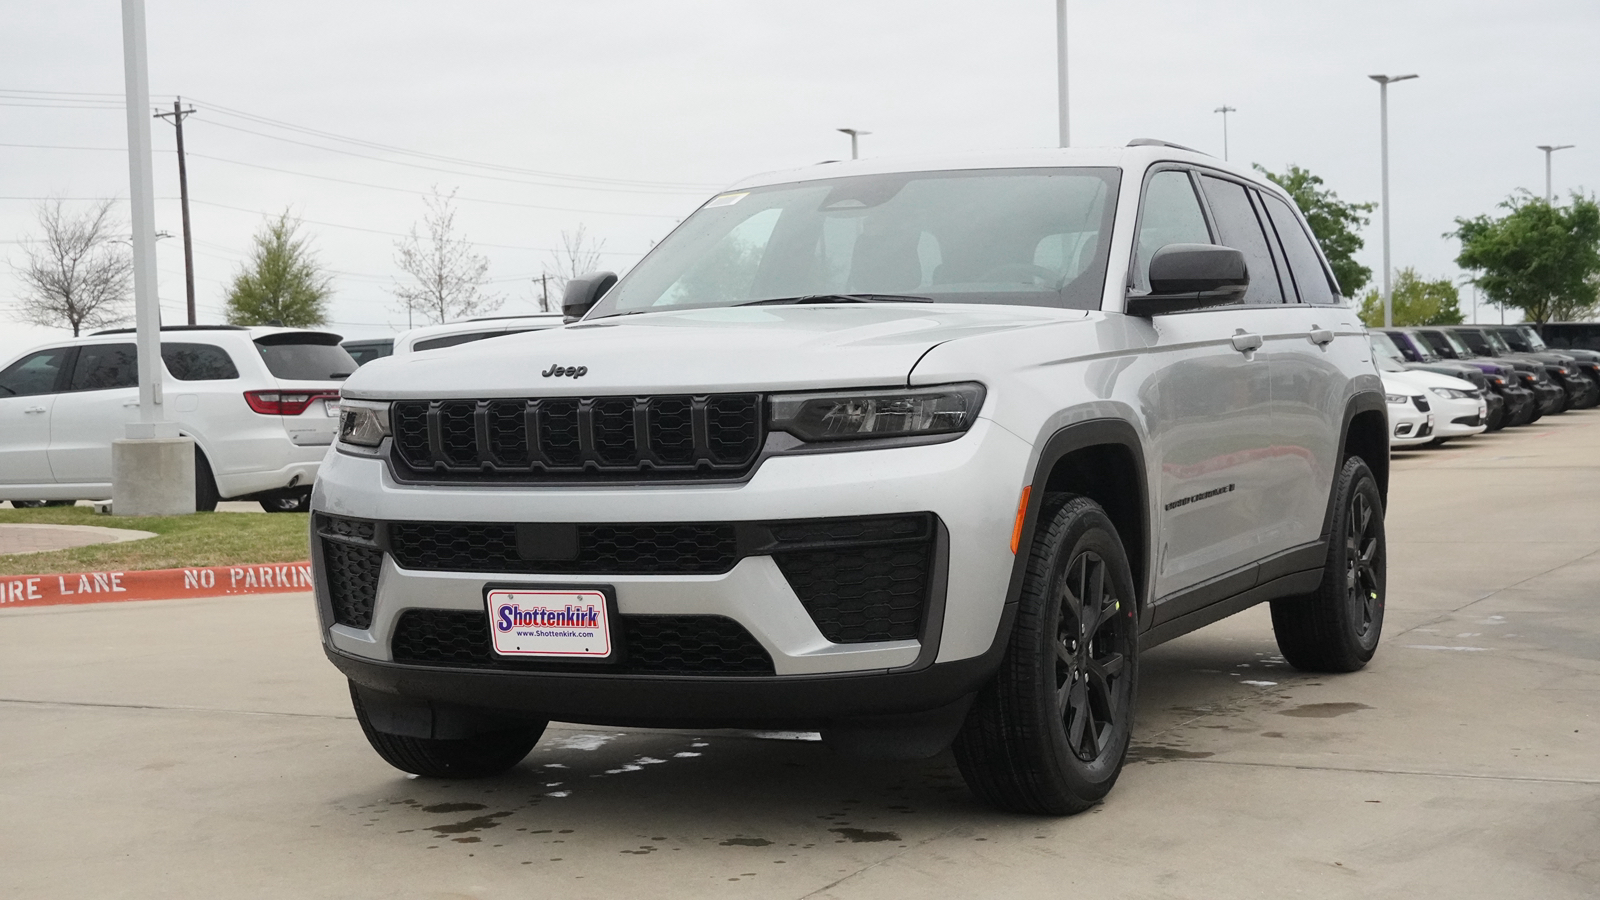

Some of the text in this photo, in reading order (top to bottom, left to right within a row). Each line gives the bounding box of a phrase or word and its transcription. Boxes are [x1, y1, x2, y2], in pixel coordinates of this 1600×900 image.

[541, 363, 588, 380] Jeep
[0, 572, 127, 604] IRE LANE
[184, 565, 313, 590] NO PARKIN
[497, 603, 600, 633] Shottenkirk
[516, 630, 594, 638] www.Shottenkirk.com
